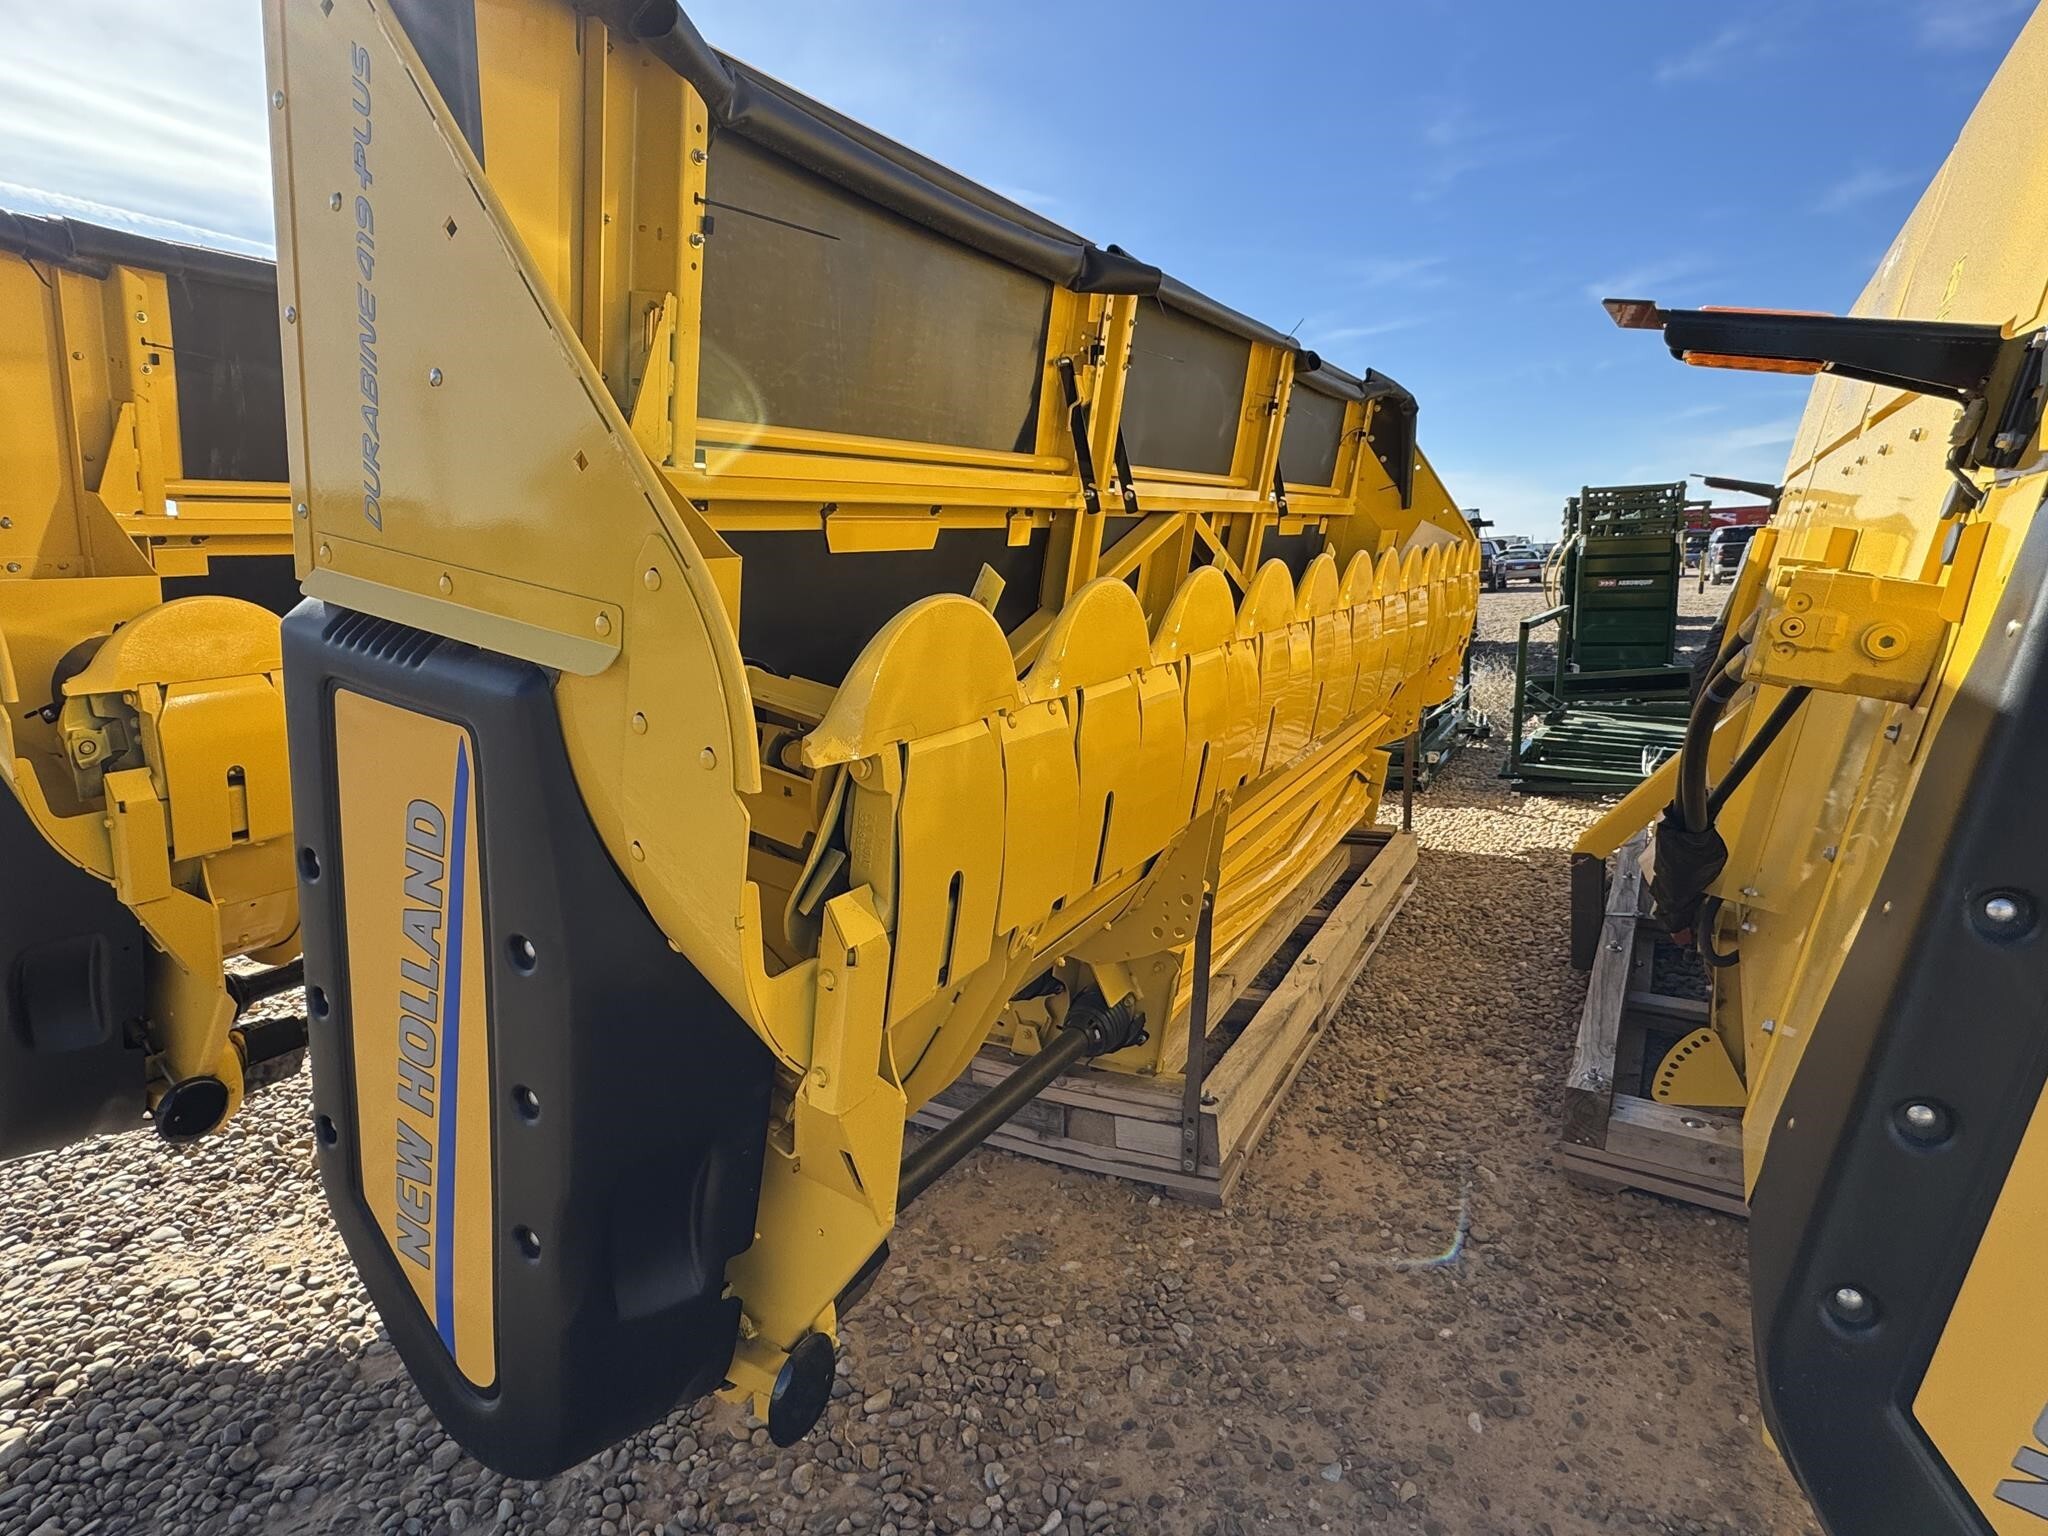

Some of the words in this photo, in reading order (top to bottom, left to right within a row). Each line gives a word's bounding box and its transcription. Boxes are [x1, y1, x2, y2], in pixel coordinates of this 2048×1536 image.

[356, 195, 375, 281] 419
[356, 281, 383, 531] DURABINE
[396, 798, 447, 1118] HOLLAND
[396, 1117, 434, 1270] NEW
